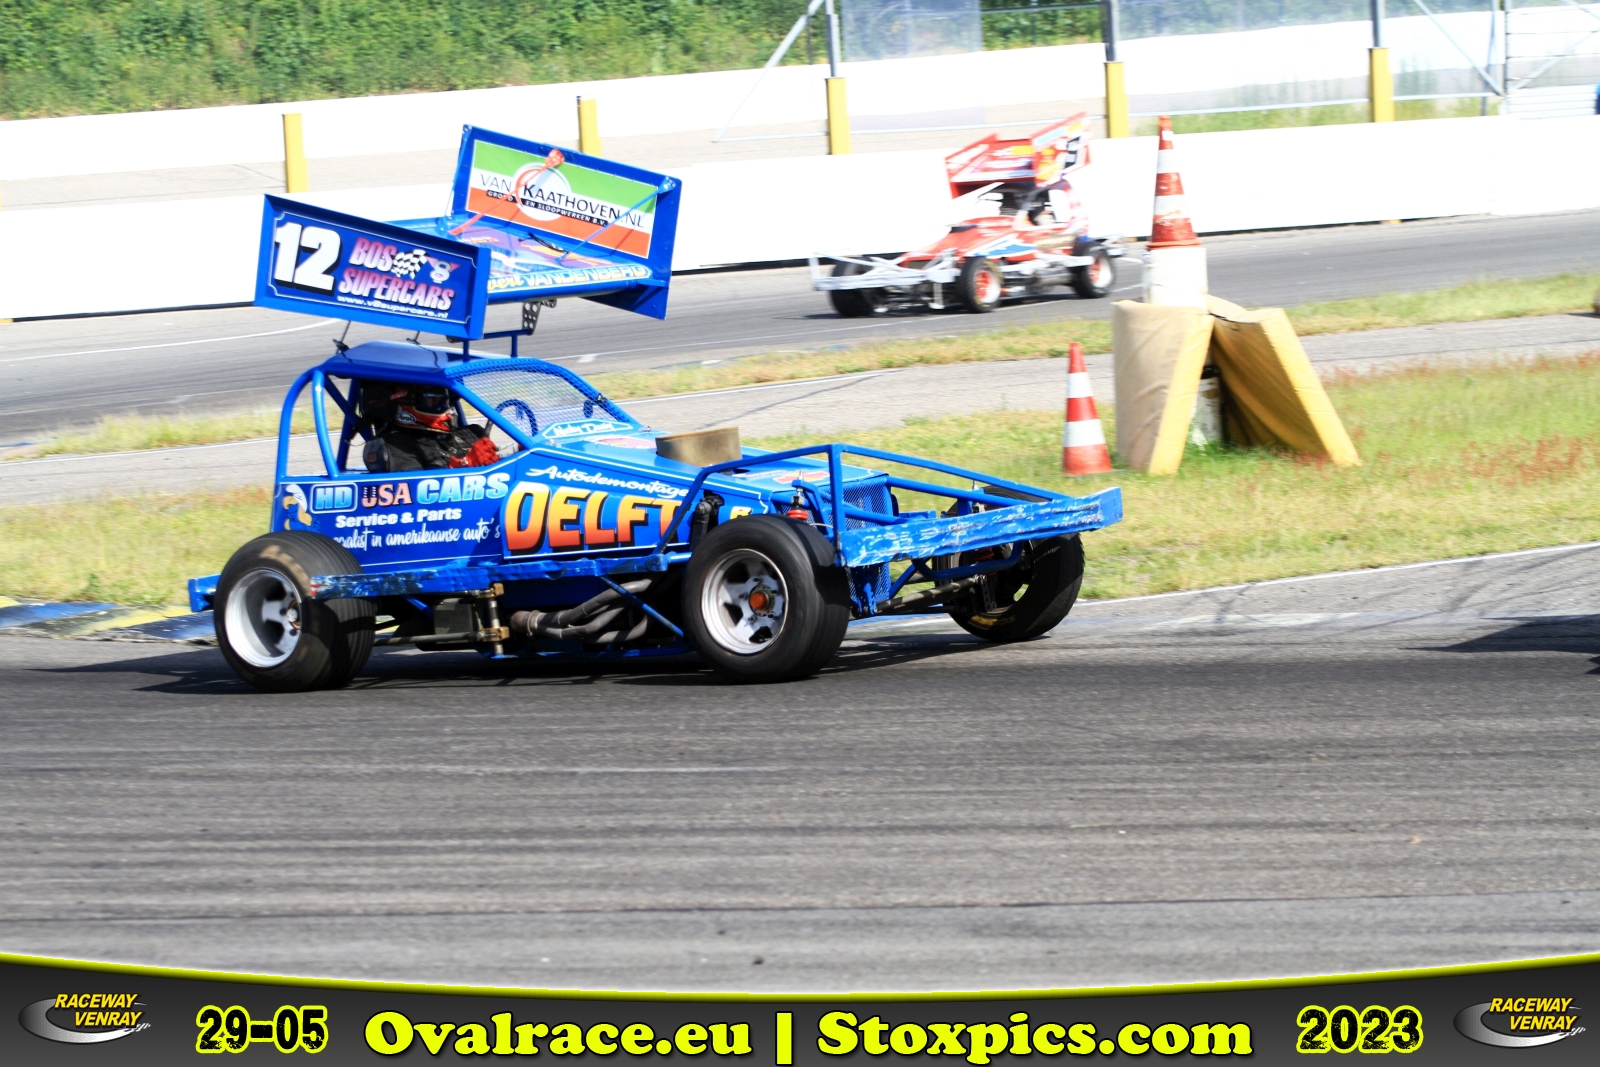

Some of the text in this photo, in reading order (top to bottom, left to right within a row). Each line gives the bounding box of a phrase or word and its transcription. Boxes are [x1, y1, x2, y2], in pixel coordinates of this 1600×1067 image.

[480, 173, 645, 229] VAN KAATHOVEN.NL
[525, 200, 536, 209] EN
[537, 203, 591, 223] SLOOPWERKEN
[274, 221, 343, 295] 12
[349, 236, 399, 273] BOS
[337, 267, 456, 312] SUPERCARS
[520, 263, 648, 288] VANDENBERG
[337, 295, 449, 320] www.v8supercars.nl
[315, 472, 511, 509] HD USA CARS
[526, 465, 691, 499] Autodemontage
[335, 507, 462, 529] Service & Parts
[505, 481, 687, 553] DELFT
[371, 535, 383, 548] in
[386, 522, 460, 547] amerikaanse
